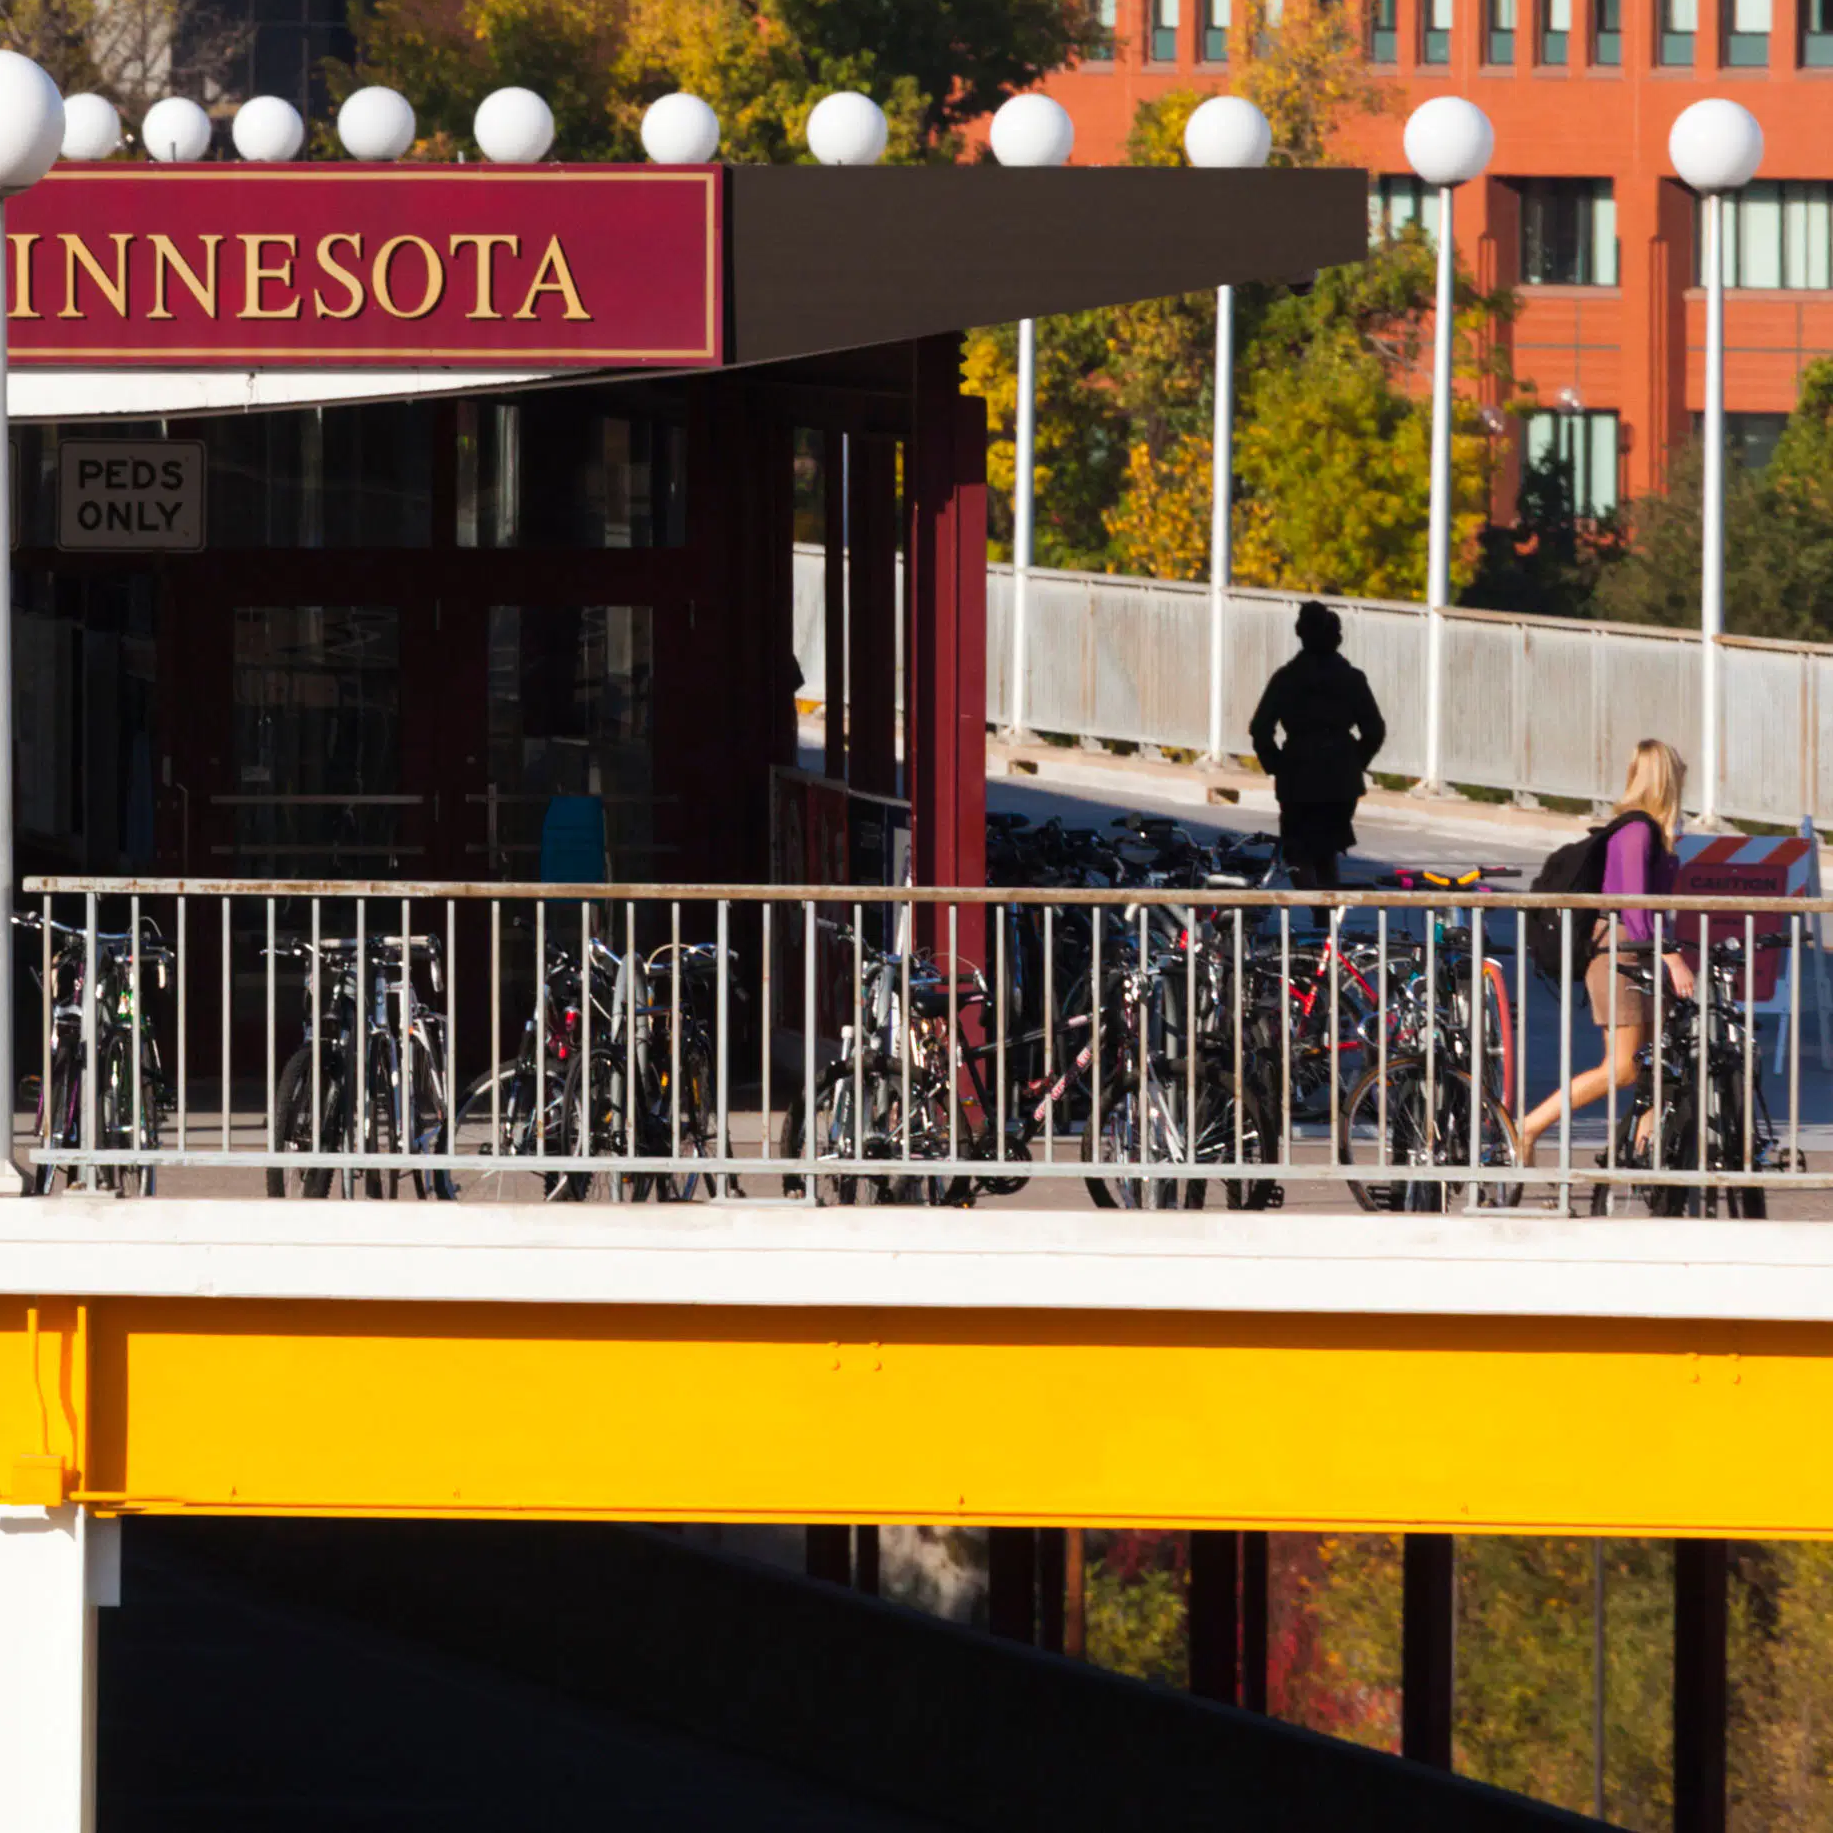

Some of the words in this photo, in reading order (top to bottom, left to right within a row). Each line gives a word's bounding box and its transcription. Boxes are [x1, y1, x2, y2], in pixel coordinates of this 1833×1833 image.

[78, 459, 184, 491] PEDS
[77, 500, 183, 532] ONLY
[1690, 876, 1777, 891] CAUTION
